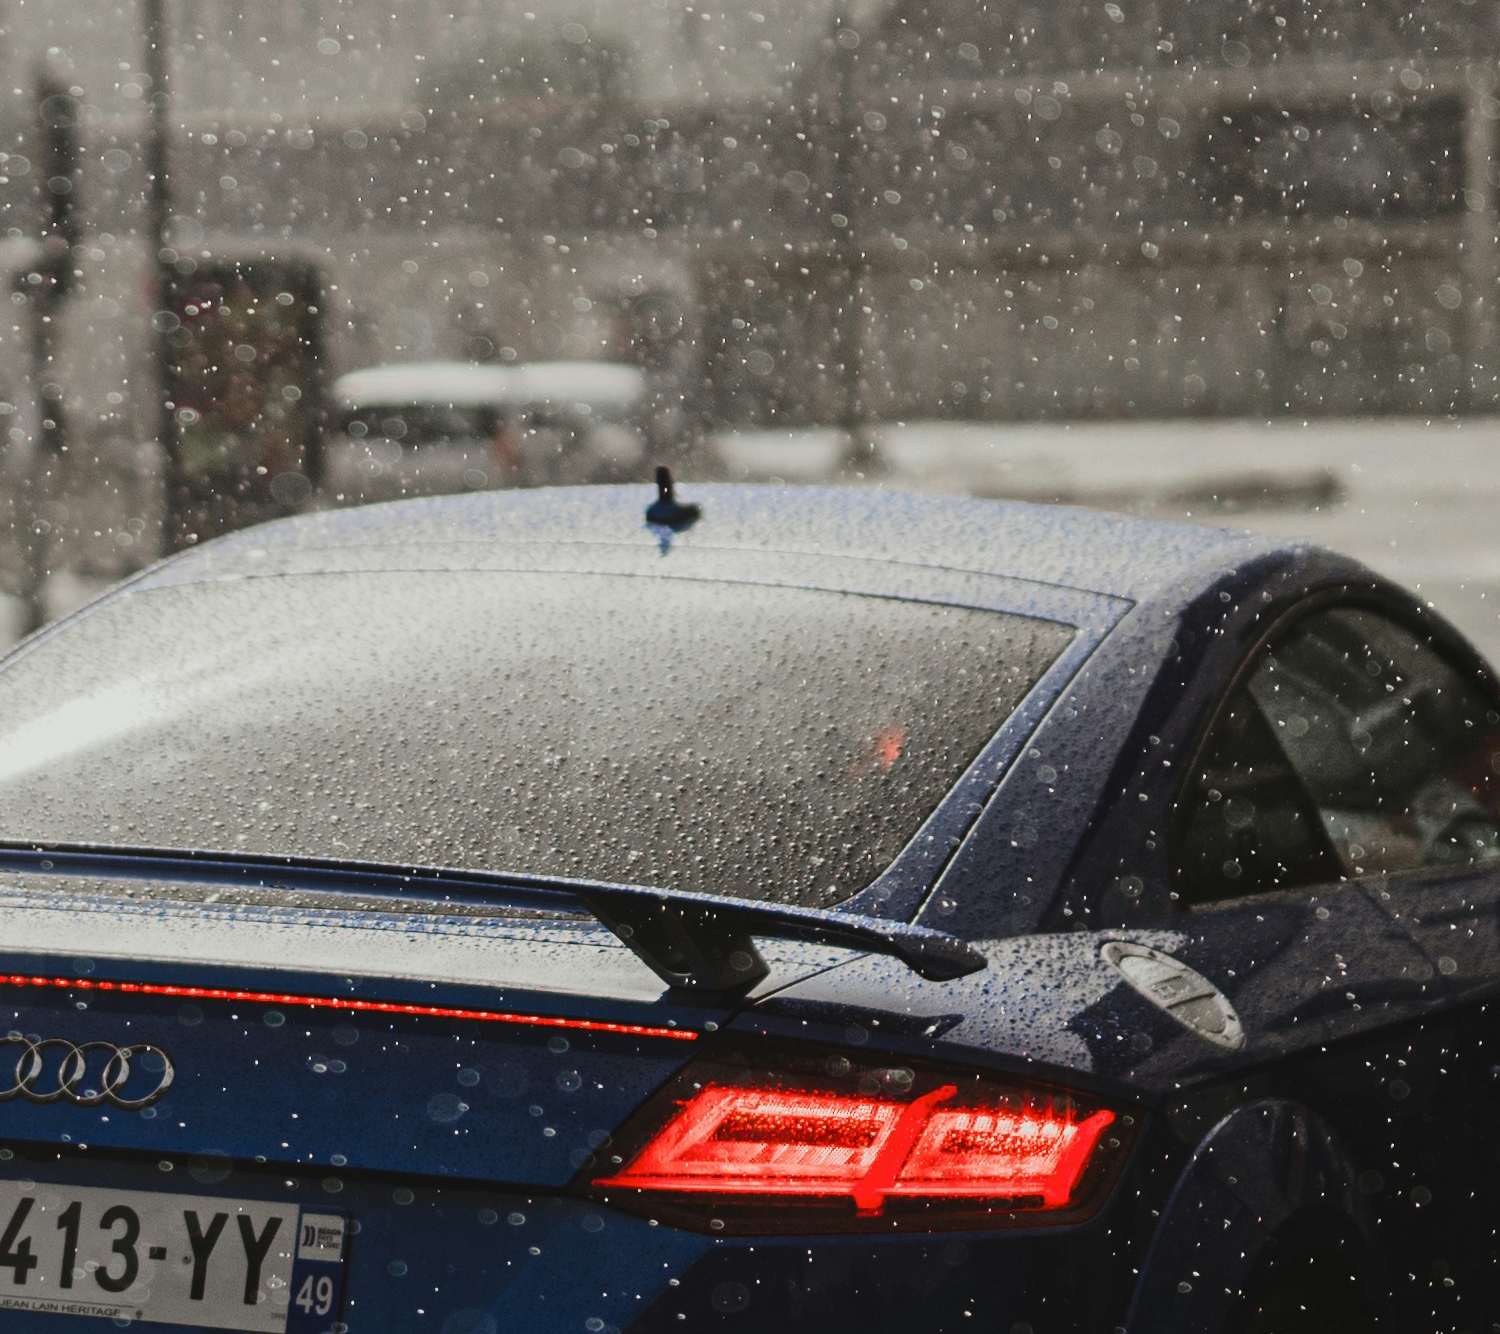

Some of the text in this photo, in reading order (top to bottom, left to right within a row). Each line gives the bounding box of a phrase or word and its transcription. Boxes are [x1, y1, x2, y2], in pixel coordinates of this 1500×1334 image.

[0, 1299, 29, 1309] JEAN
[32, 1302, 59, 1312] LAIN
[295, 1274, 333, 1316] 49
